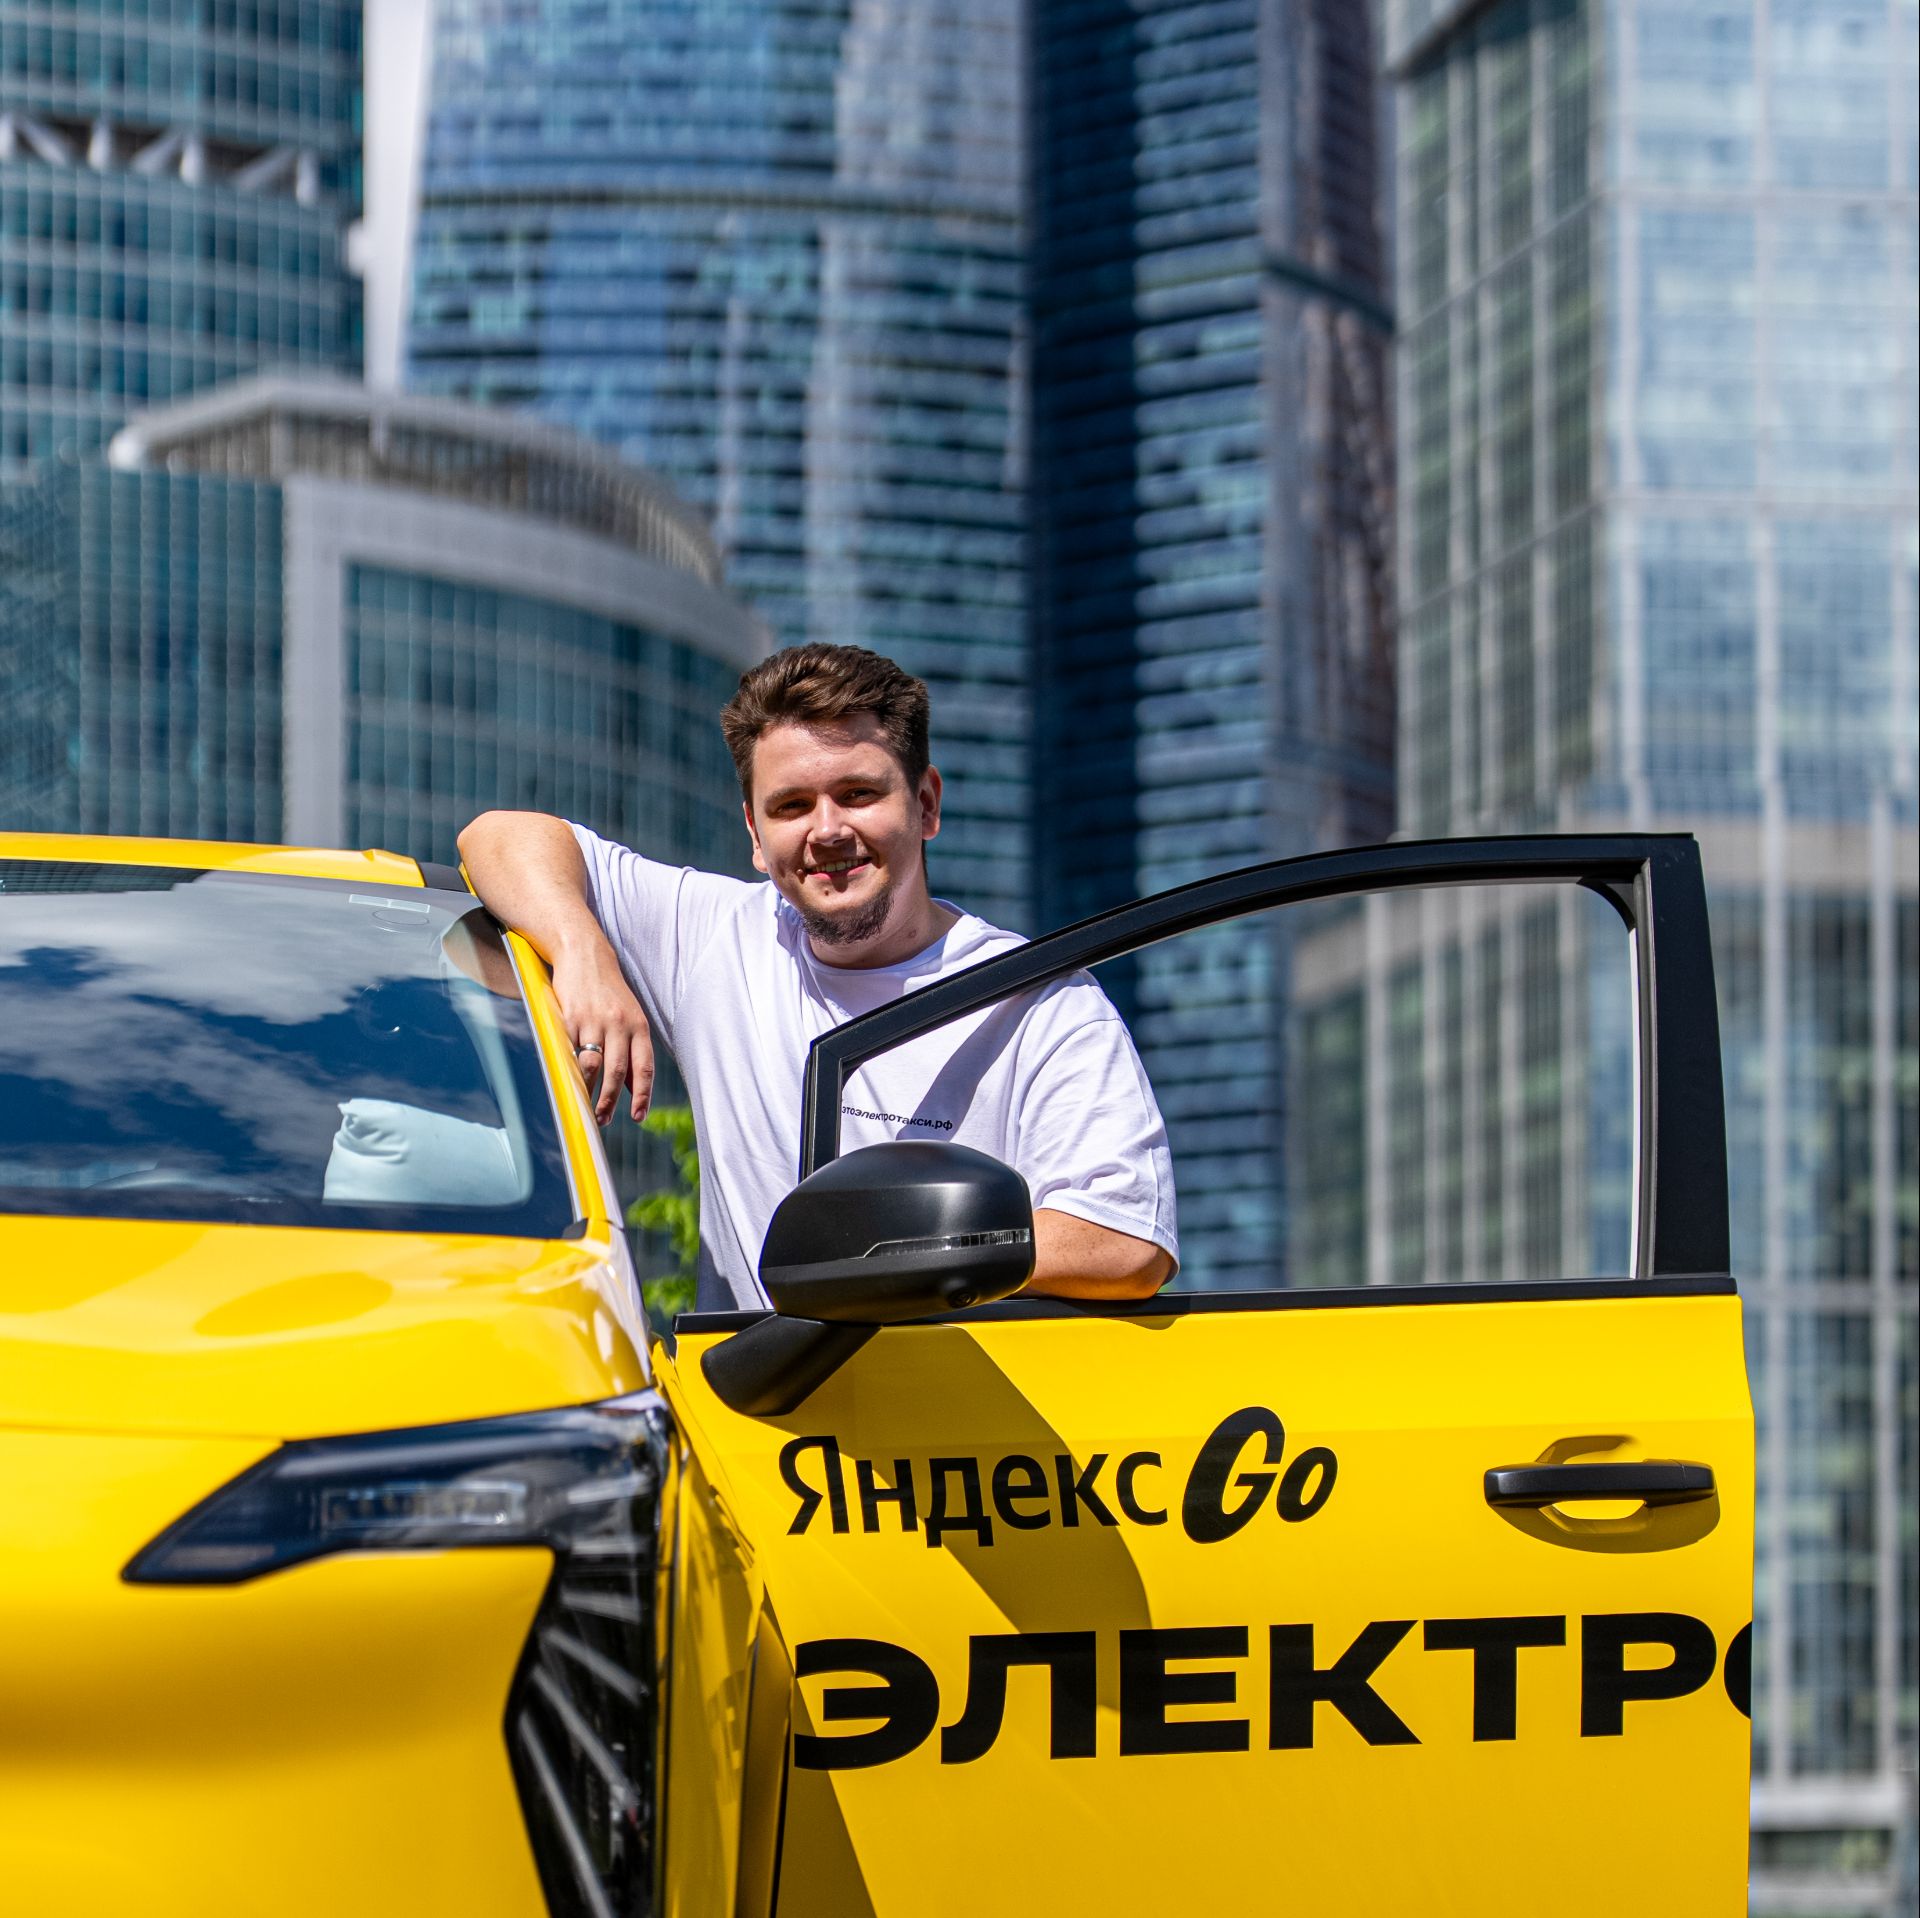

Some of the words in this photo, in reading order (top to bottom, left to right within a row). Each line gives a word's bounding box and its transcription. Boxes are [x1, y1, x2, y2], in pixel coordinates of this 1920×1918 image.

[841, 1106, 953, 1131] этоэлектротакси.рф
[778, 1435, 1169, 1548] Яндекс
[1181, 1406, 1338, 1544] Go
[793, 1612, 1753, 1770] ЭЛЕКТР
